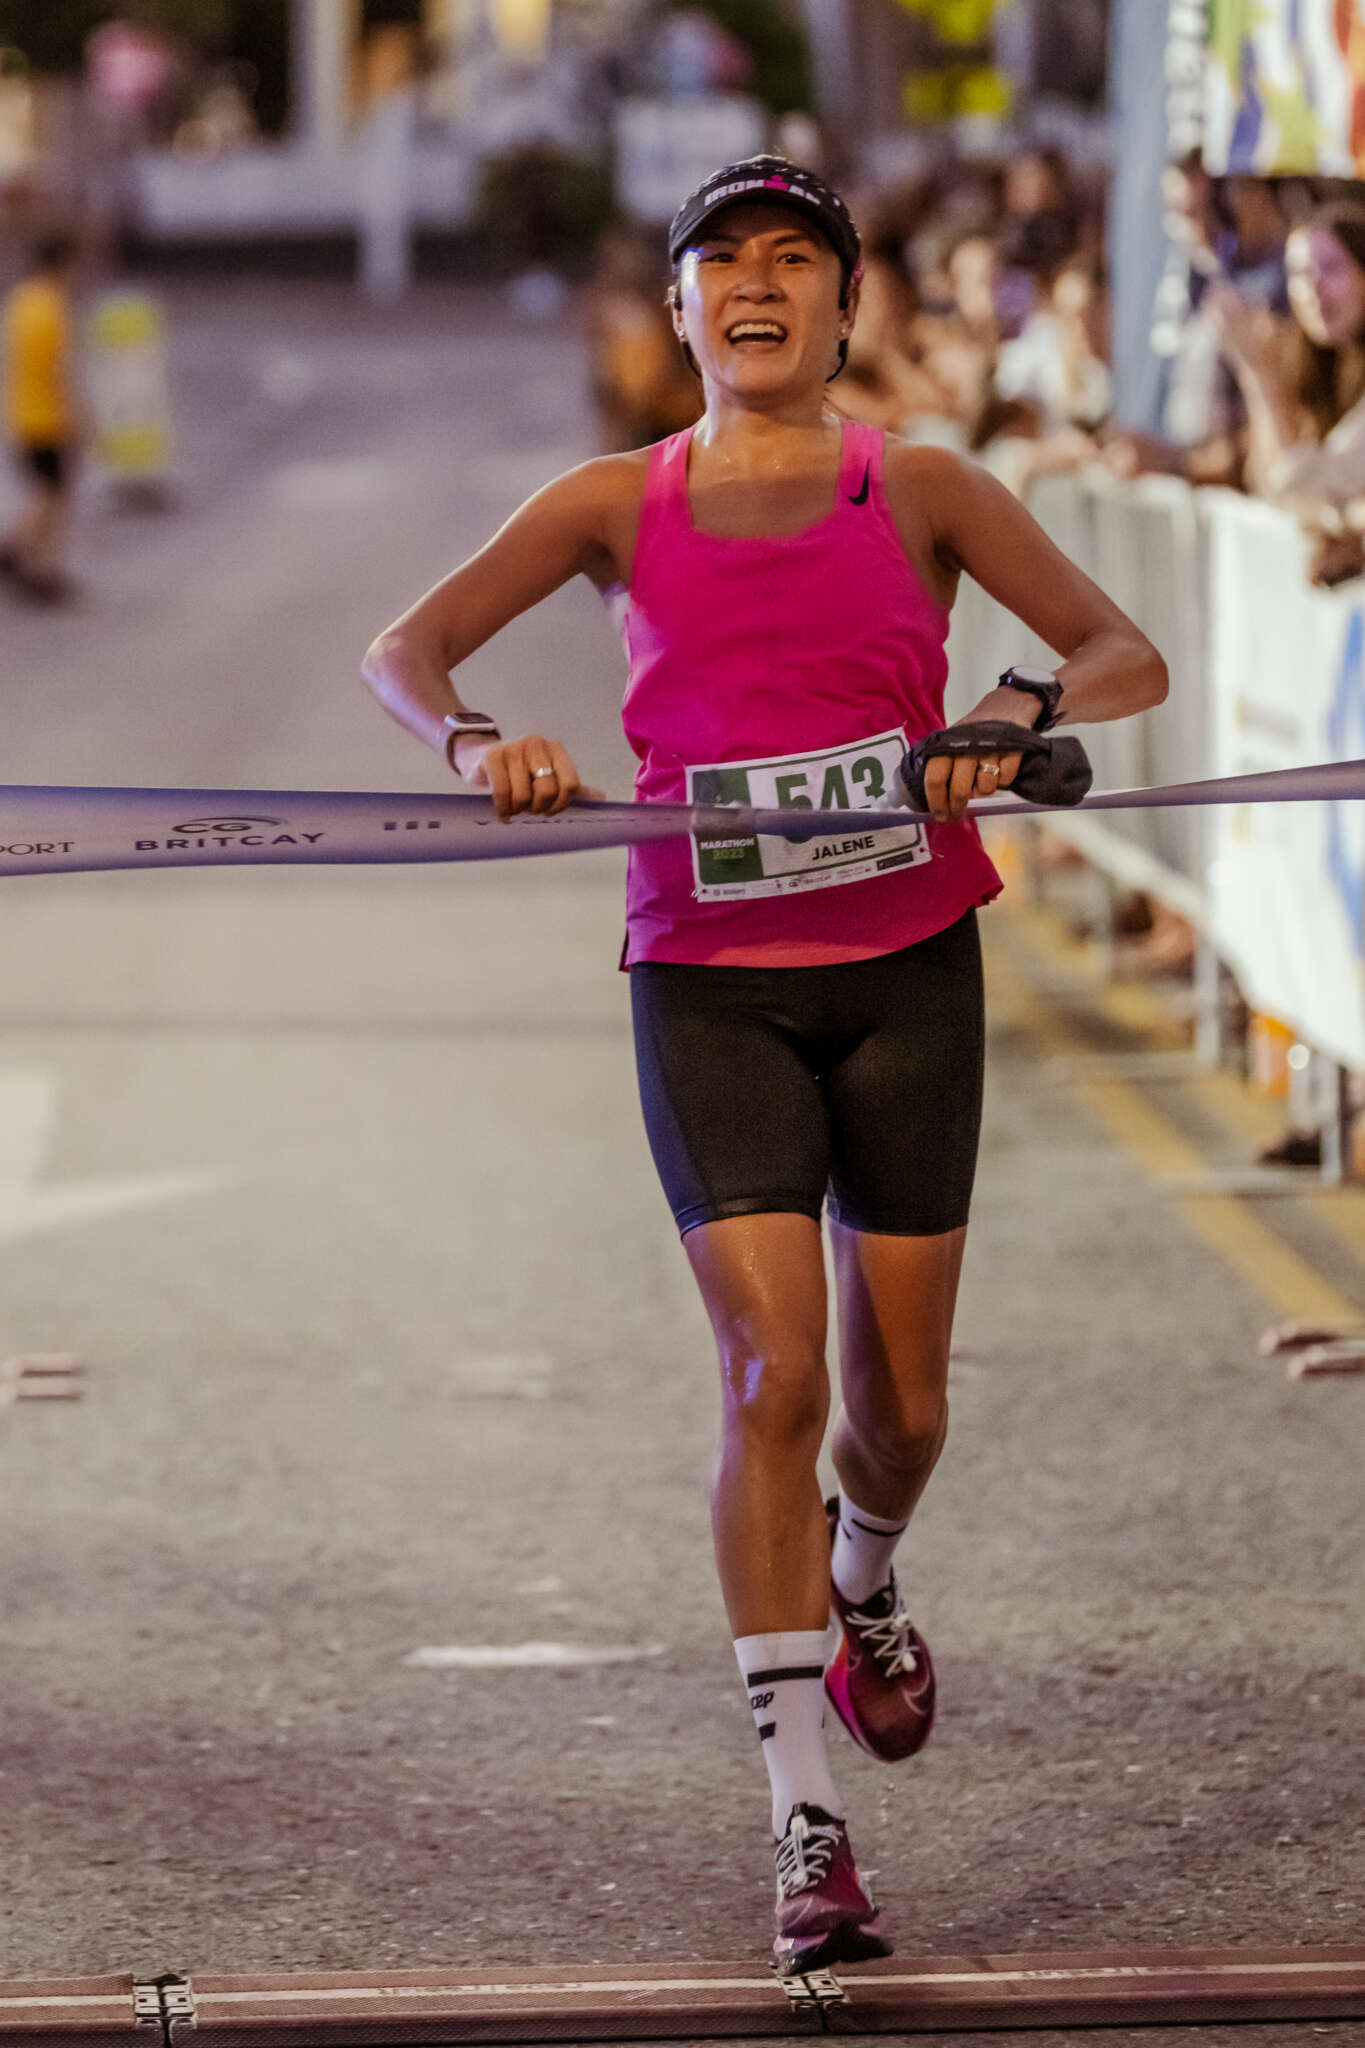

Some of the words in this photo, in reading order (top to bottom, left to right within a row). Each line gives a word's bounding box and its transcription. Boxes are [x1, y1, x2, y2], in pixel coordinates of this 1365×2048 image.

[134, 832, 325, 852] BRITCAY
[700, 837, 755, 850] MARATHON
[811, 835, 876, 861] JALENE
